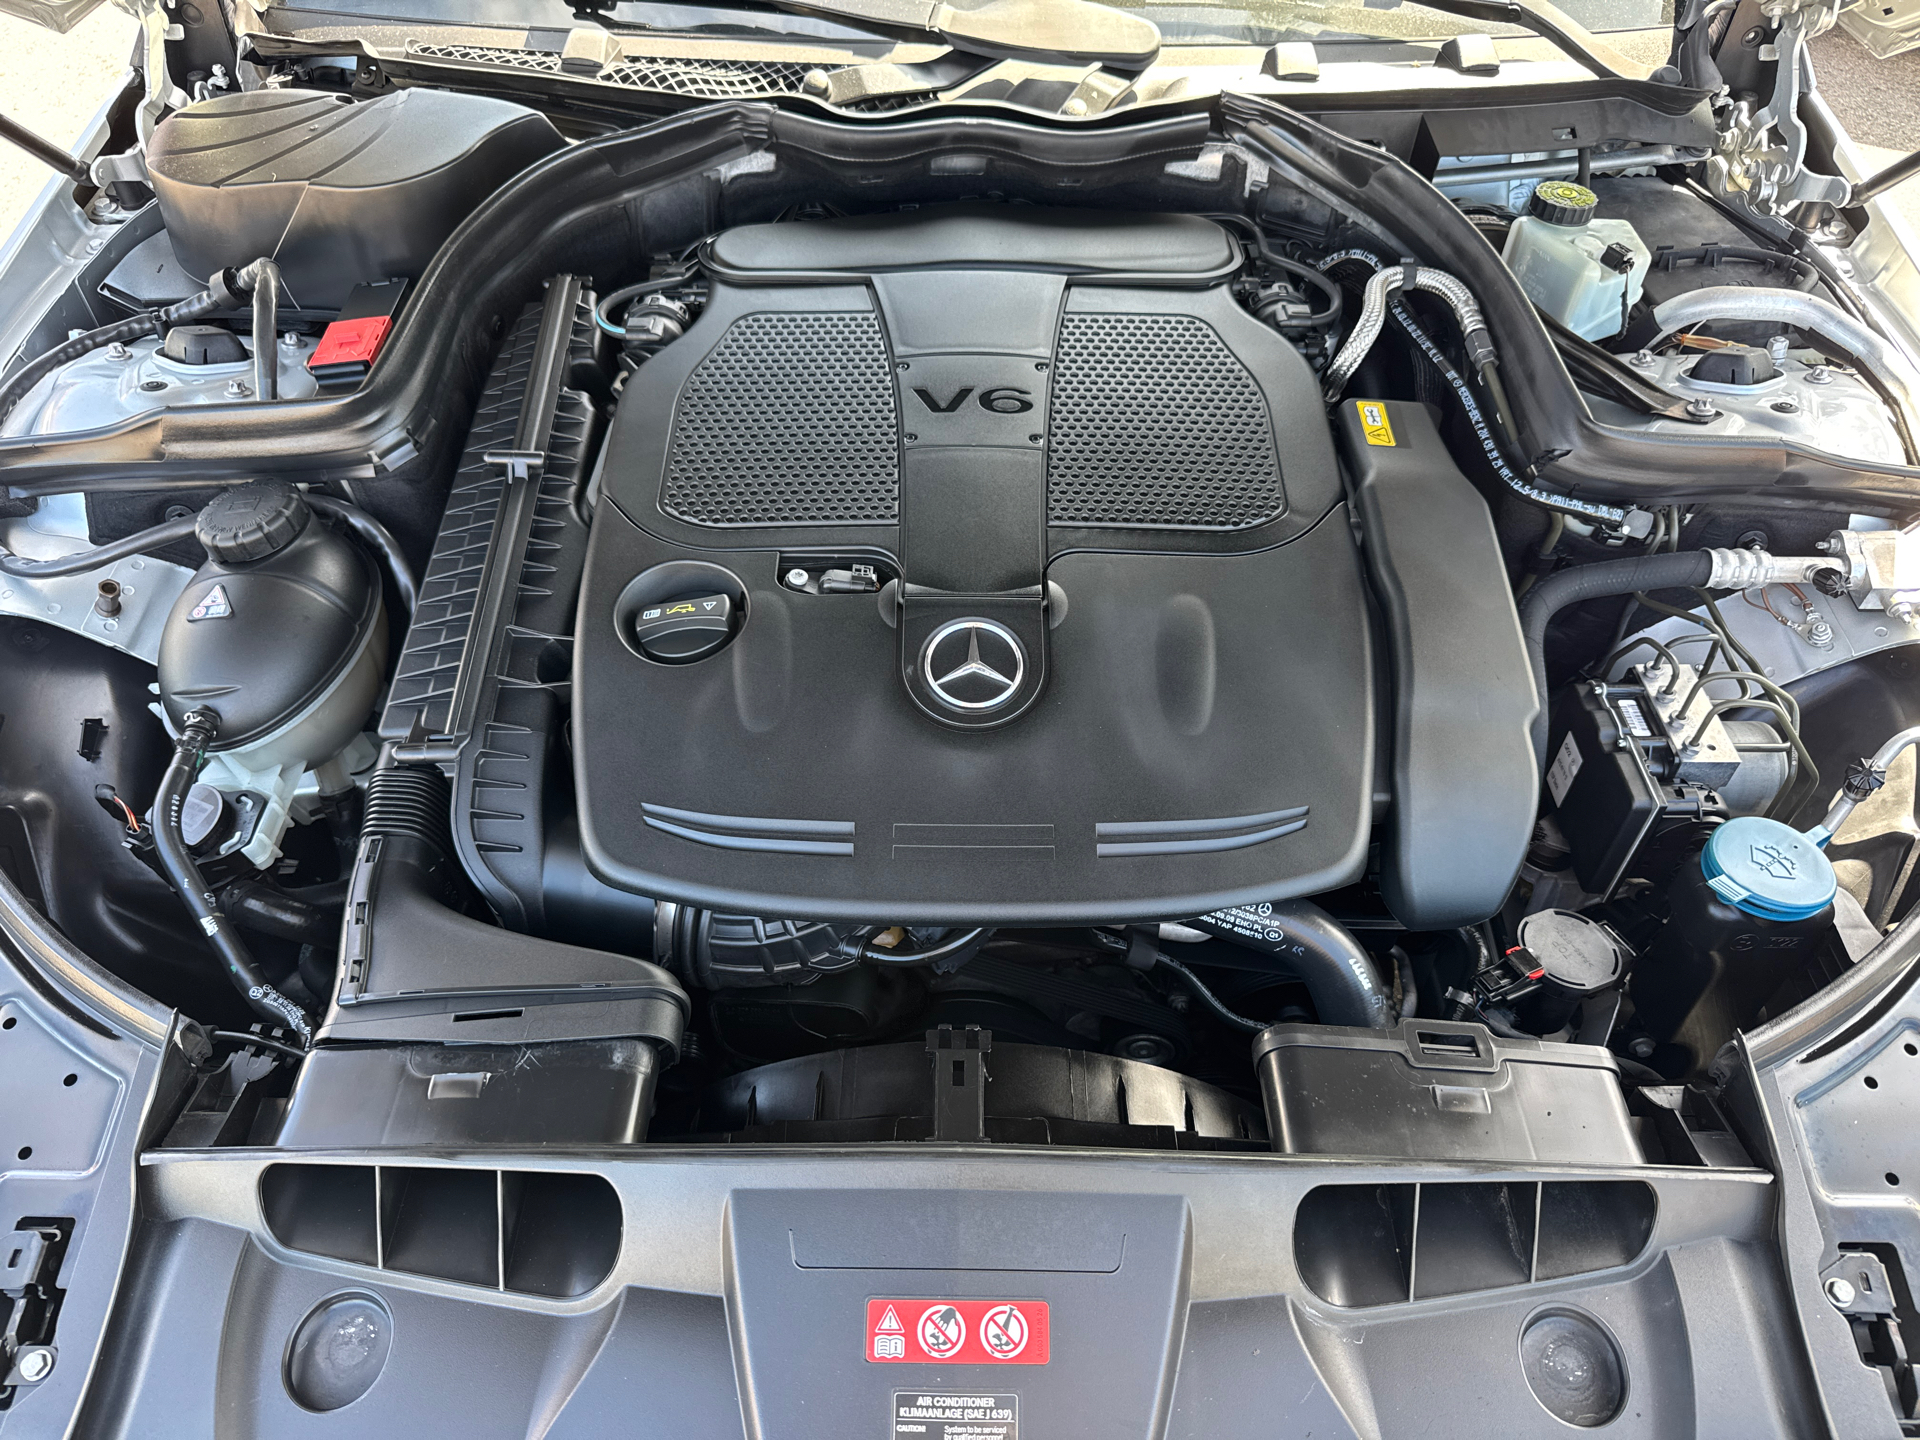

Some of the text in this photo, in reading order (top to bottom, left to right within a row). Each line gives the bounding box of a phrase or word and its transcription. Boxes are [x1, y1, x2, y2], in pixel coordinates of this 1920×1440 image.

[912, 387, 1034, 414] V6
[1217, 919, 1233, 930] YAP
[1253, 924, 1264, 933] PL
[1552, 940, 1572, 960] TOP
[916, 1396, 995, 1407] AIR CONDITIONER
[899, 1407, 1012, 1420] KLIMAANLAGE (SAE J 639)
[944, 1425, 967, 1435] System
